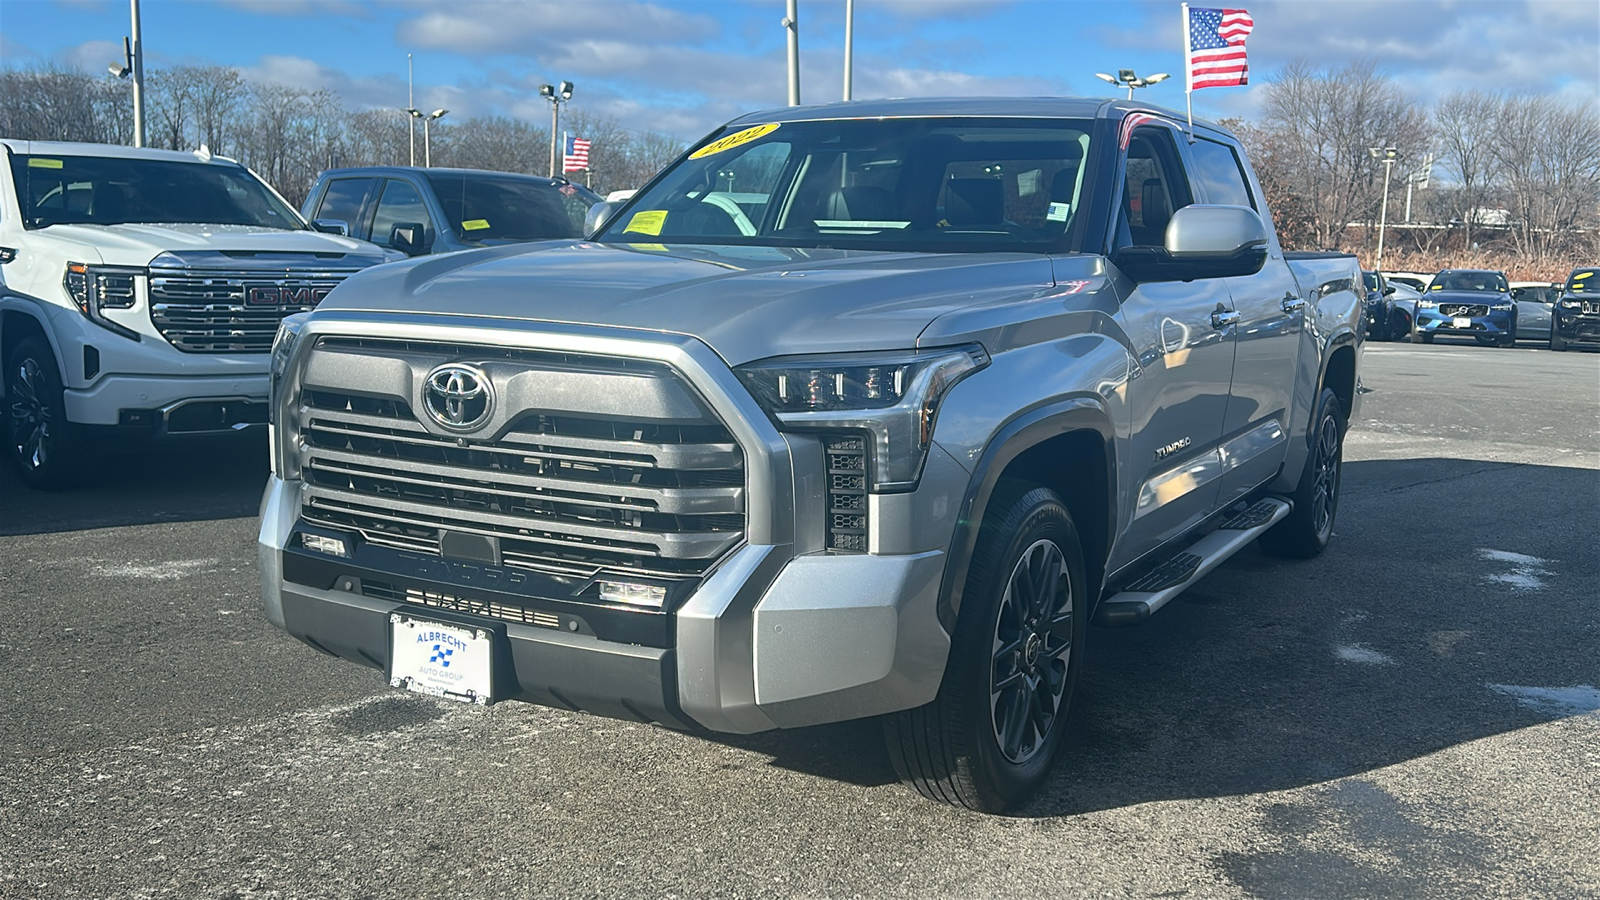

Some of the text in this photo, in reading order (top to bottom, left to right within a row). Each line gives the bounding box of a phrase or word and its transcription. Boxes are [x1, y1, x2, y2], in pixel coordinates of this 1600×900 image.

[701, 126, 766, 156] 2022
[251, 287, 333, 303] GMC
[417, 631, 467, 652] ALBRECHT
[419, 666, 438, 676] AUTO
[439, 670, 464, 681] GROUP
